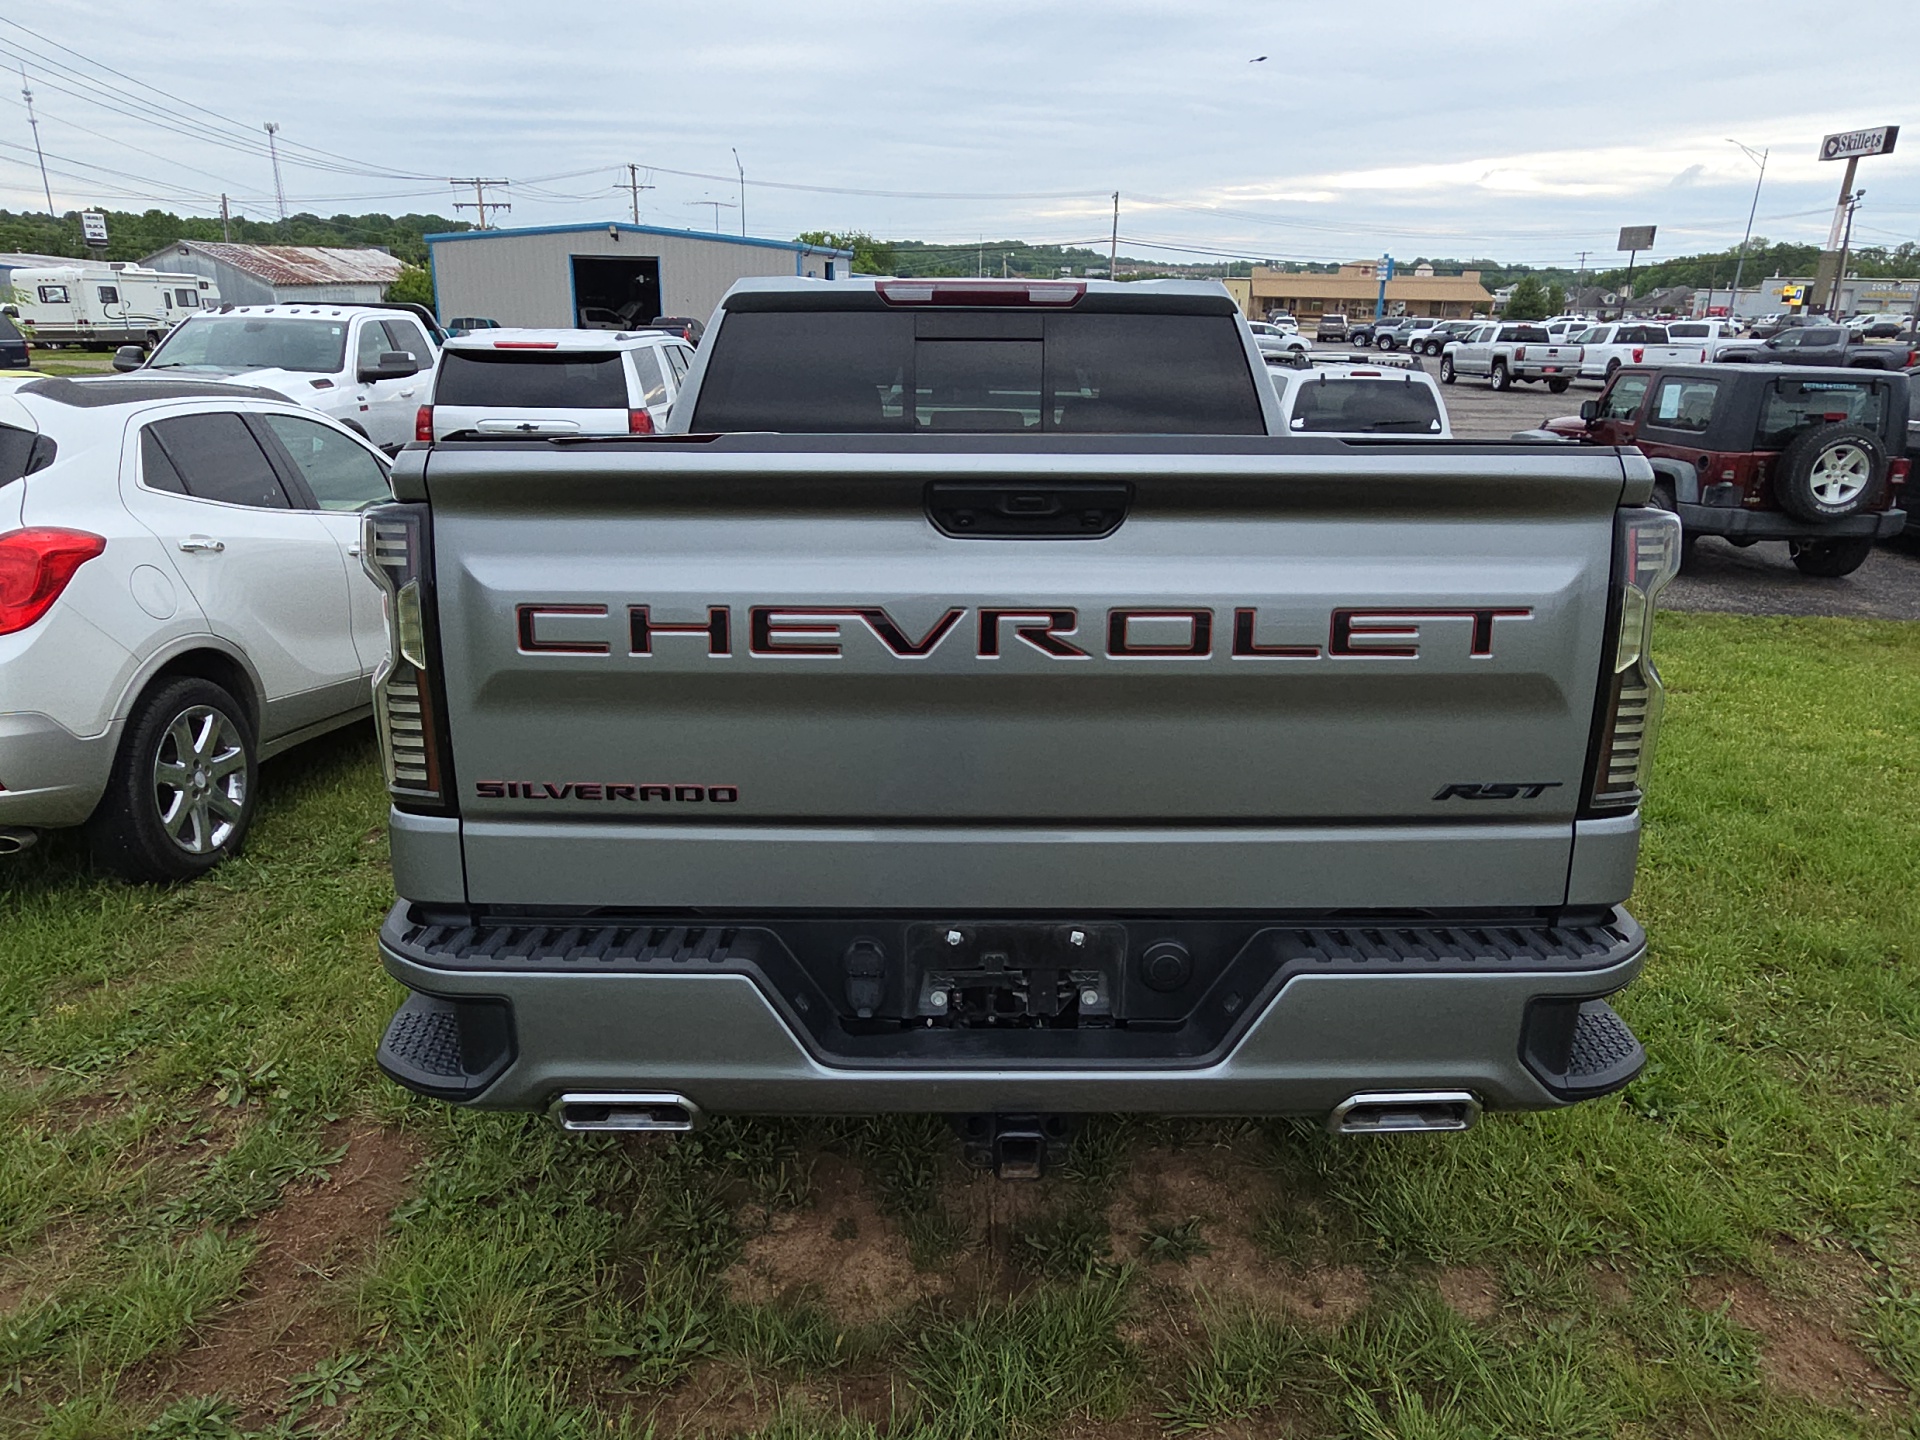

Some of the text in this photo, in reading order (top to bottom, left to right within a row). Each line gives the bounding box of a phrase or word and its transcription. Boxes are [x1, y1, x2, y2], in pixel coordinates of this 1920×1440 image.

[1839, 132, 1882, 152] Skillets
[516, 604, 1534, 659] CHEVROLET
[476, 780, 738, 802] SILVERADO
[1431, 782, 1563, 800] RST
